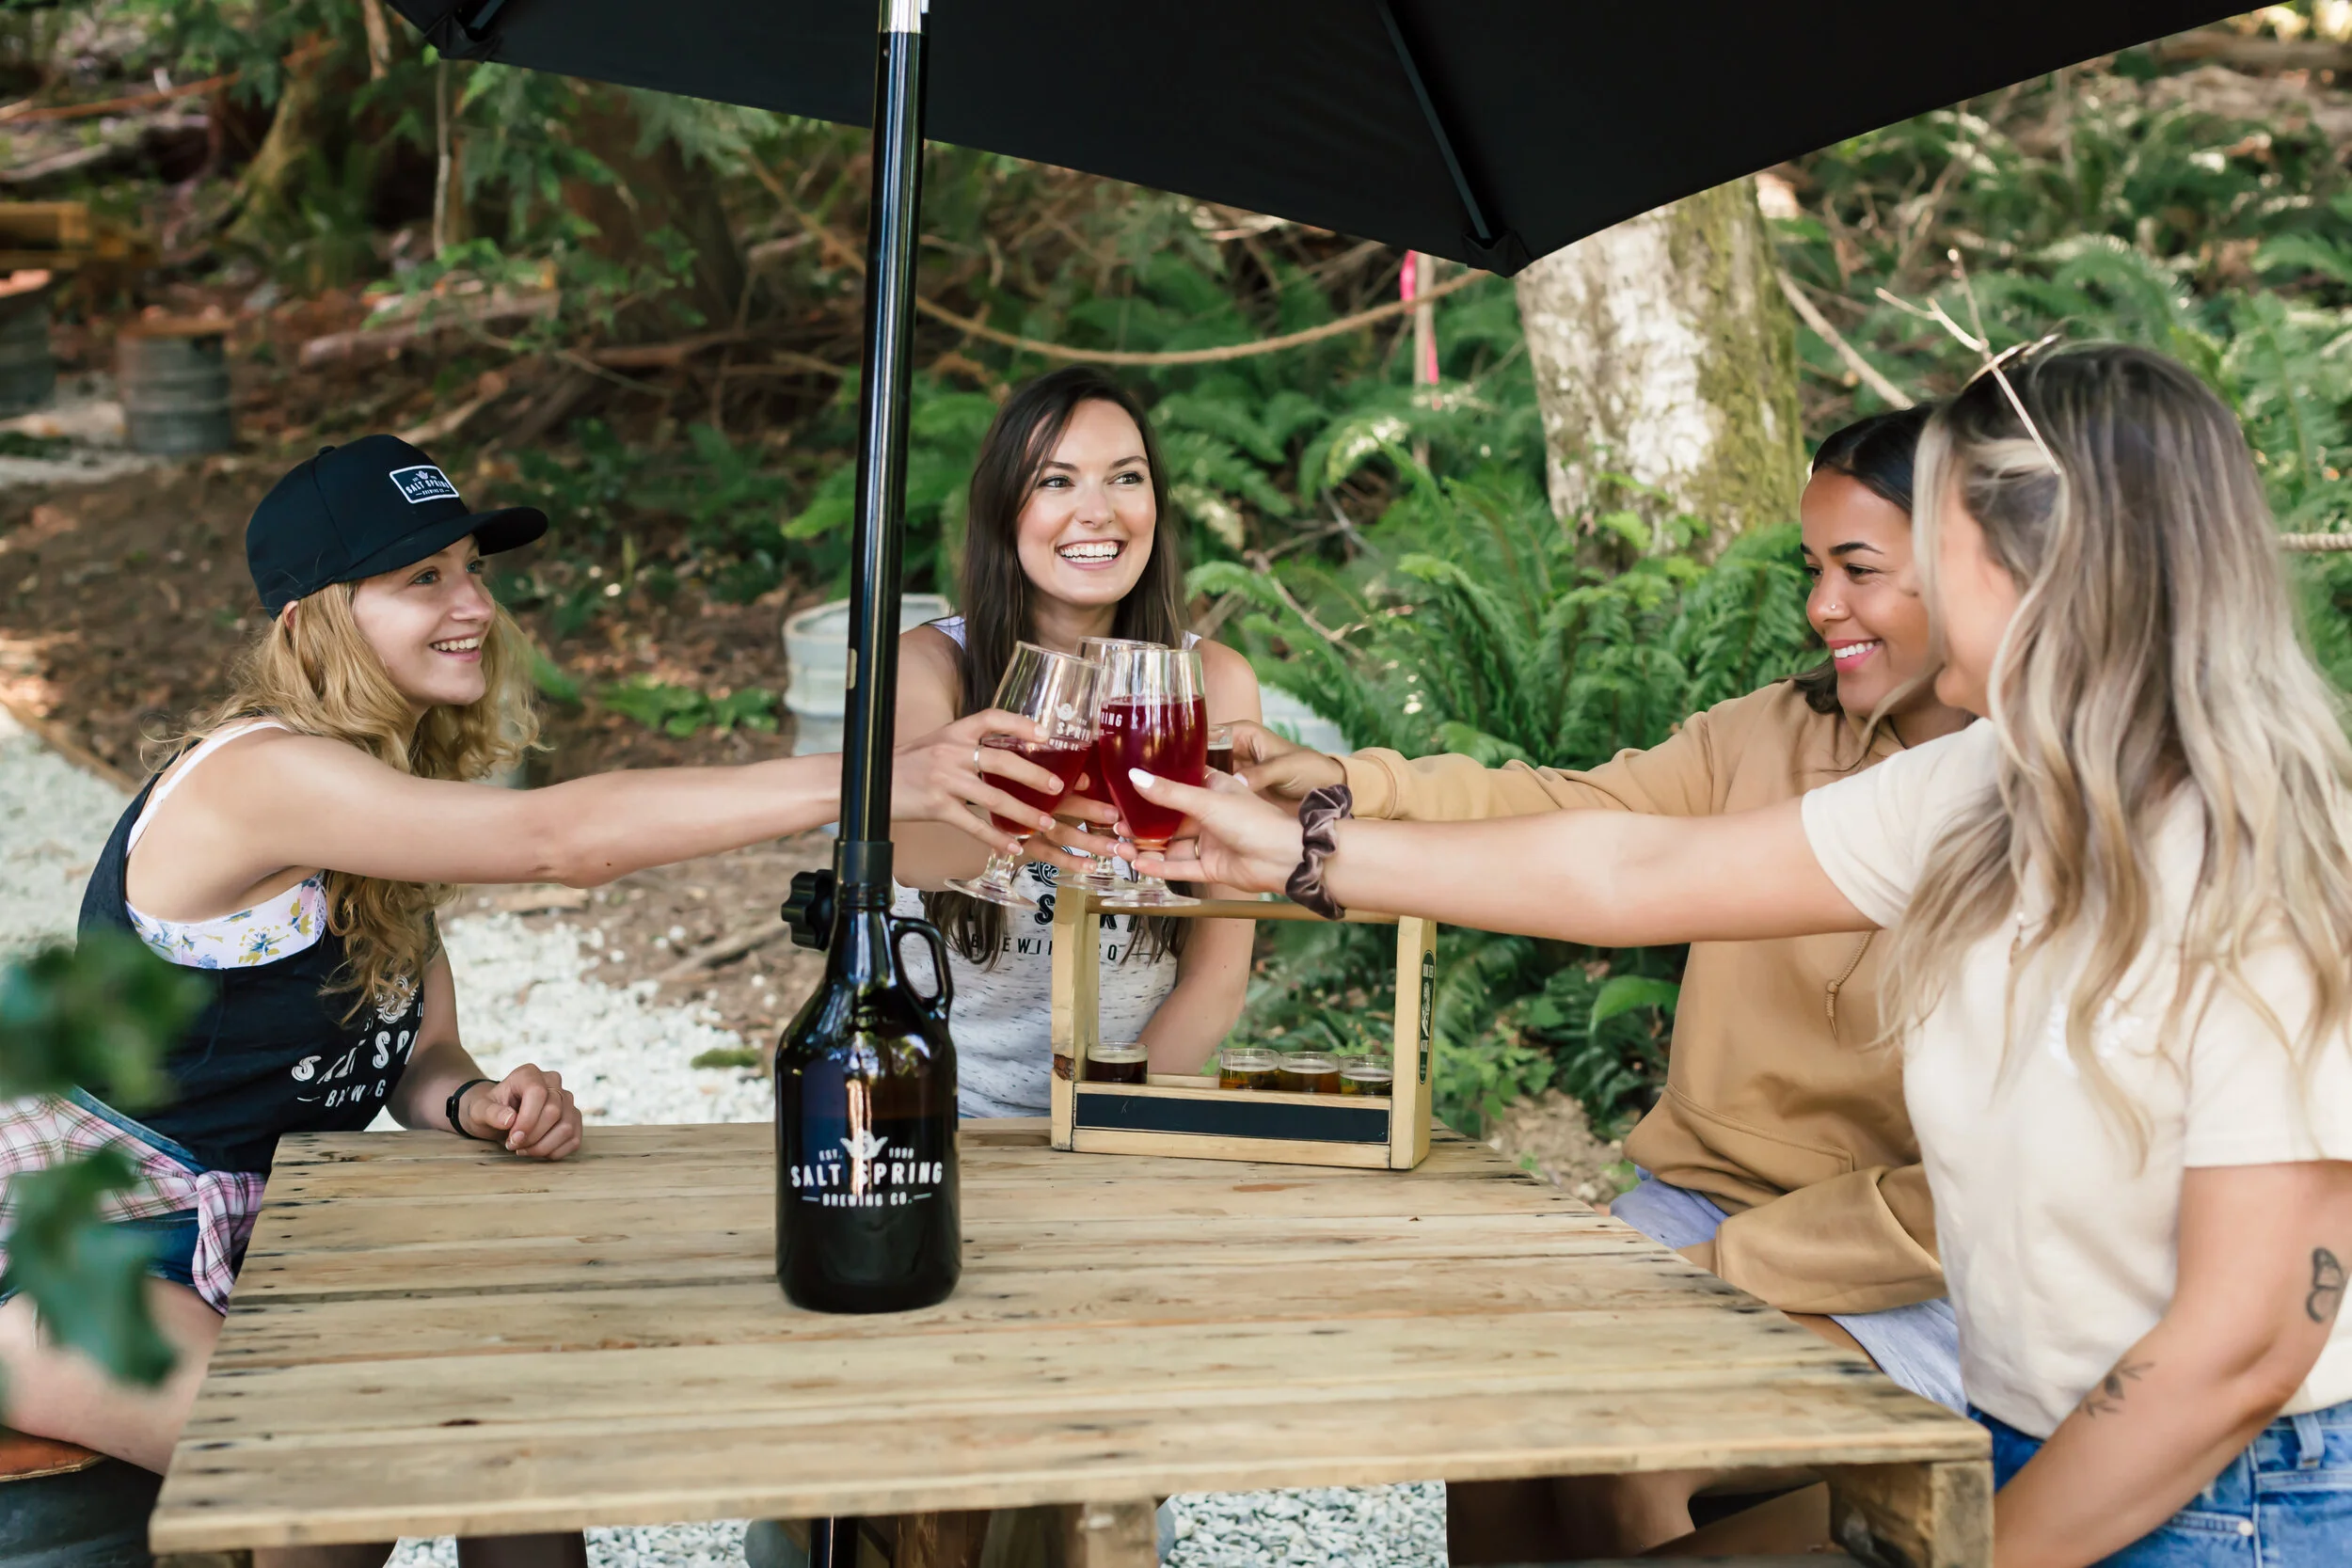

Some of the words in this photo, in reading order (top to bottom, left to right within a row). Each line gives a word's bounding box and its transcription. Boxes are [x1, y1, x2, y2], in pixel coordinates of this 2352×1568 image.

[405, 481, 424, 494] SALT
[1101, 711, 1122, 727] ING
[1057, 721, 1091, 743] SPRIN
[971, 933, 1053, 956] BEWI
[790, 1164, 841, 1188] SALT
[857, 1162, 943, 1186] SPRING
